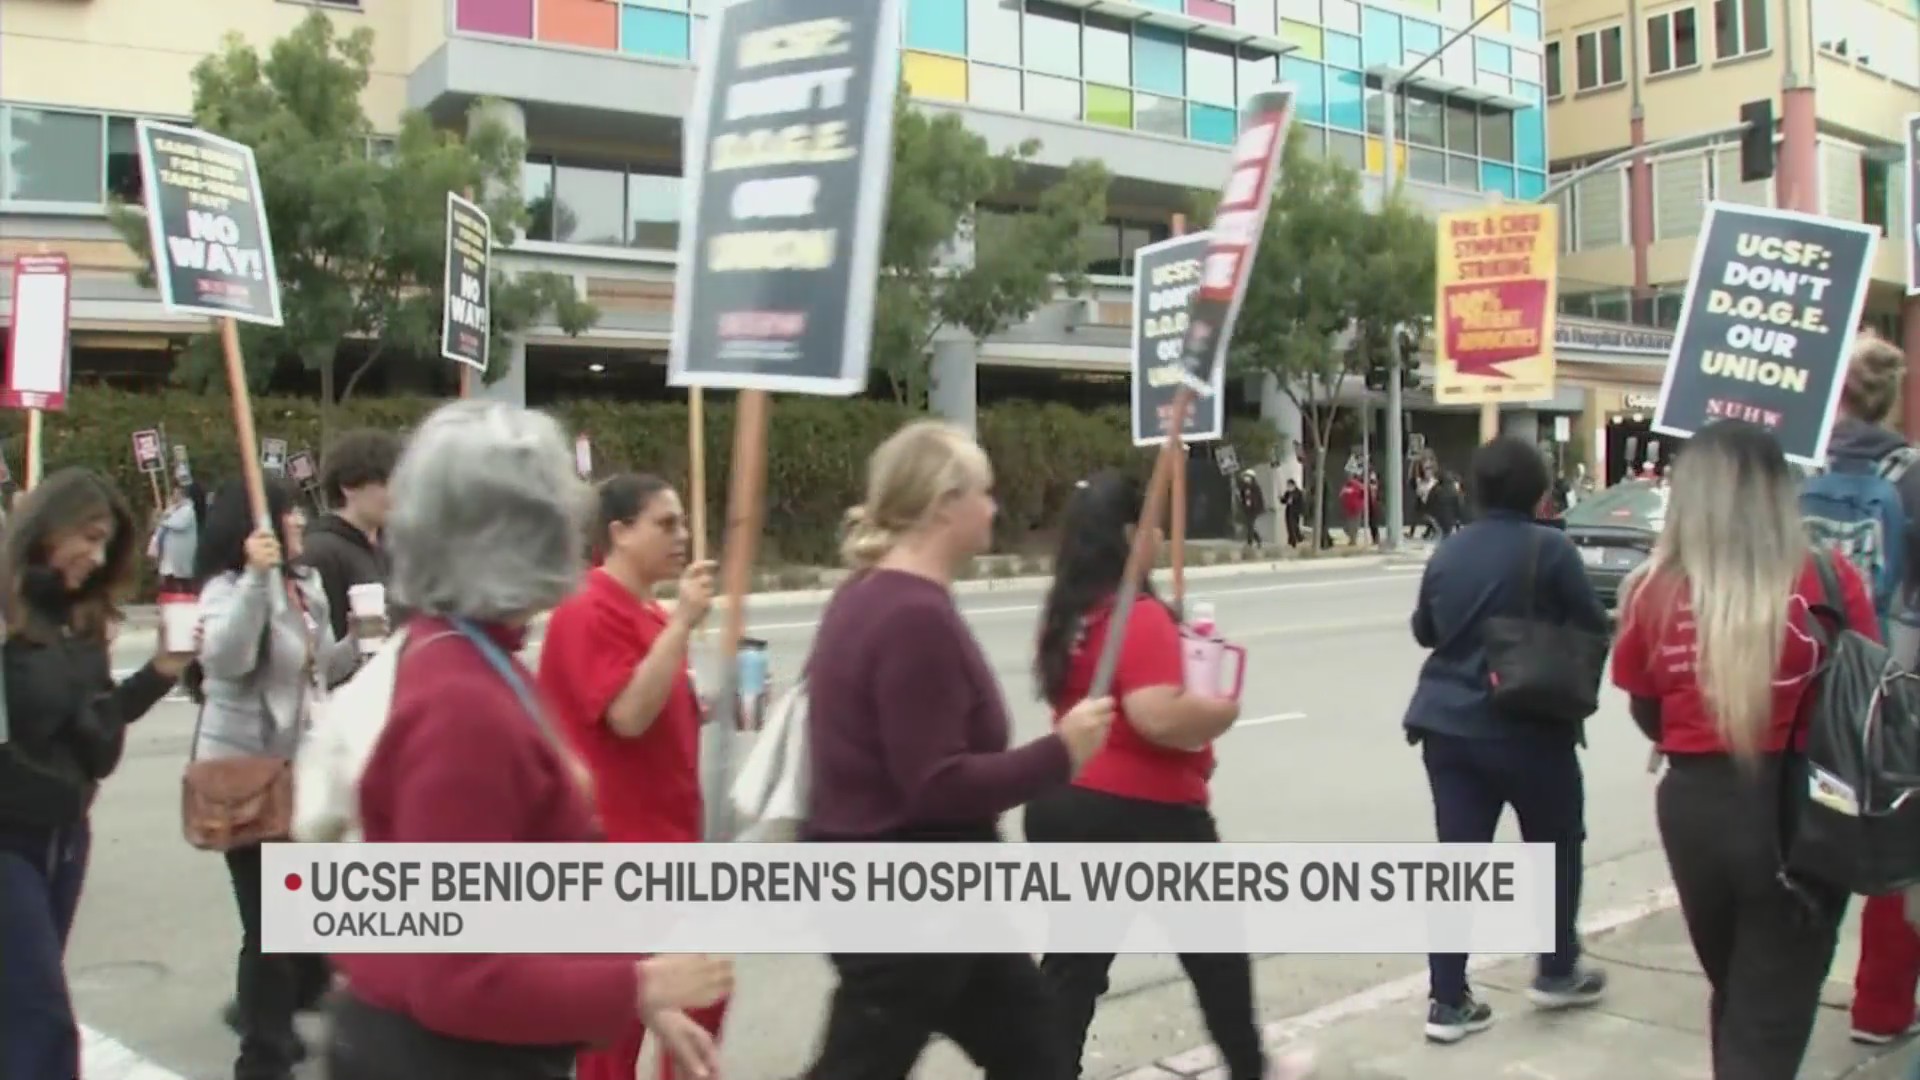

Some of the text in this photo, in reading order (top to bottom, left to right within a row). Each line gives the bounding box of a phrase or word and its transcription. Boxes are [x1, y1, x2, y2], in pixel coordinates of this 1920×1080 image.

[187, 209, 239, 245] NO
[167, 235, 264, 281] WAY!
[1455, 235, 1536, 259] SYMPATHY
[1736, 232, 1832, 271] UCSF:
[1458, 256, 1531, 280] STRIKING
[1723, 261, 1832, 302] DON'T
[461, 272, 481, 303] NO
[450, 294, 486, 333] WAY!
[1706, 289, 1830, 335] D.O.G.E.
[1726, 324, 1797, 359] OUR
[1700, 350, 1810, 393] UNION
[1705, 398, 1783, 428] NUHW
